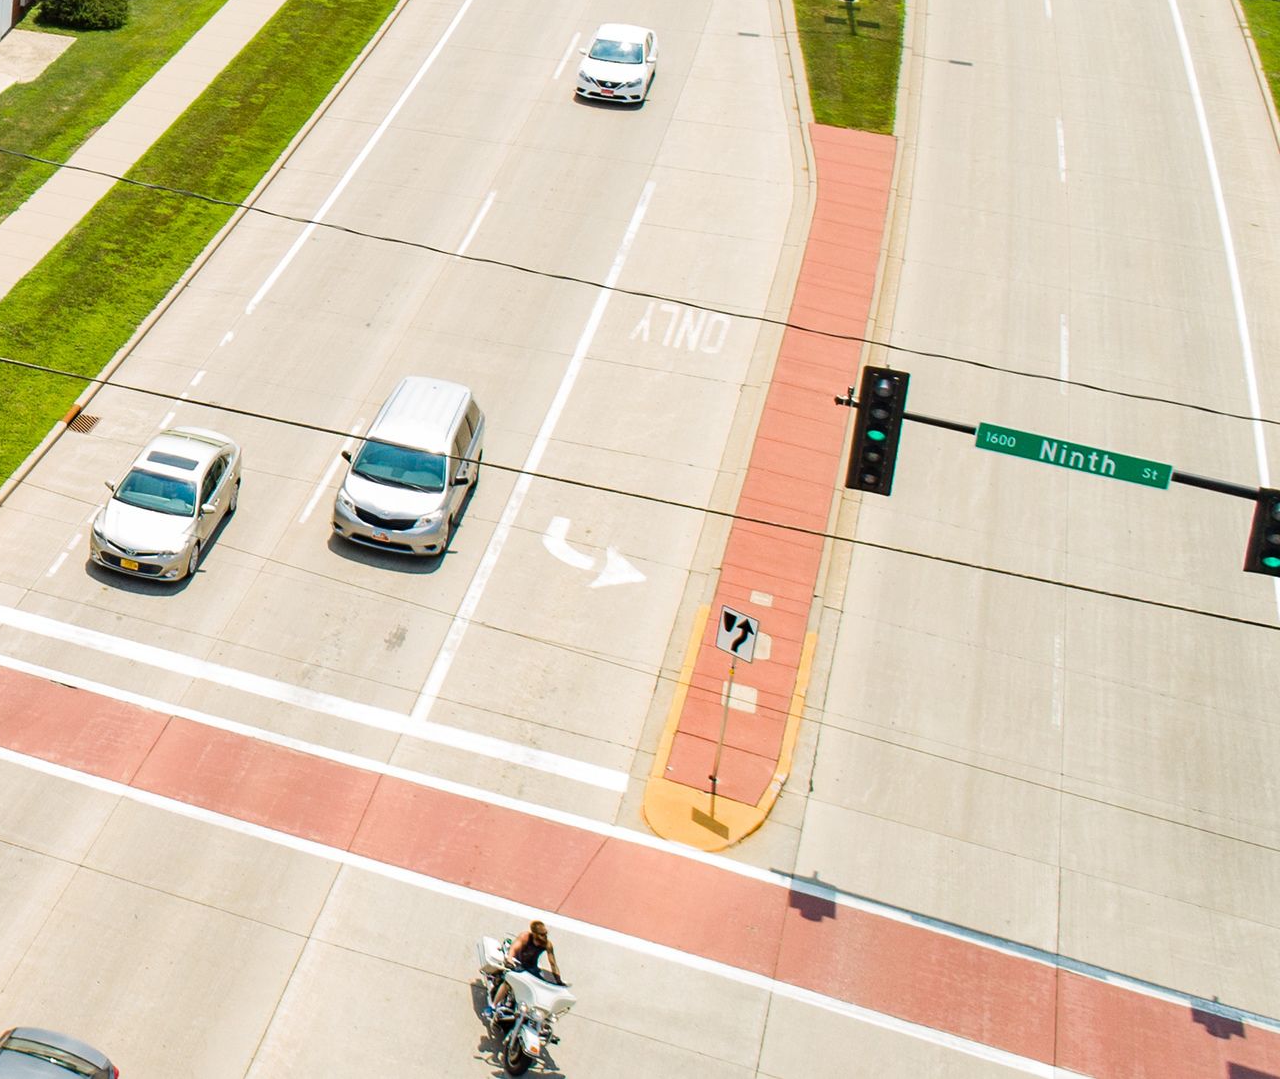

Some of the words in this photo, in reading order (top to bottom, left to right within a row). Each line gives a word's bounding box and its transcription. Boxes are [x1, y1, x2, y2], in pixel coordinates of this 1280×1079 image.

[627, 301, 733, 354] ONLY
[985, 431, 1016, 448] 1600
[1039, 439, 1117, 476] Ninth
[1141, 467, 1158, 481] St
